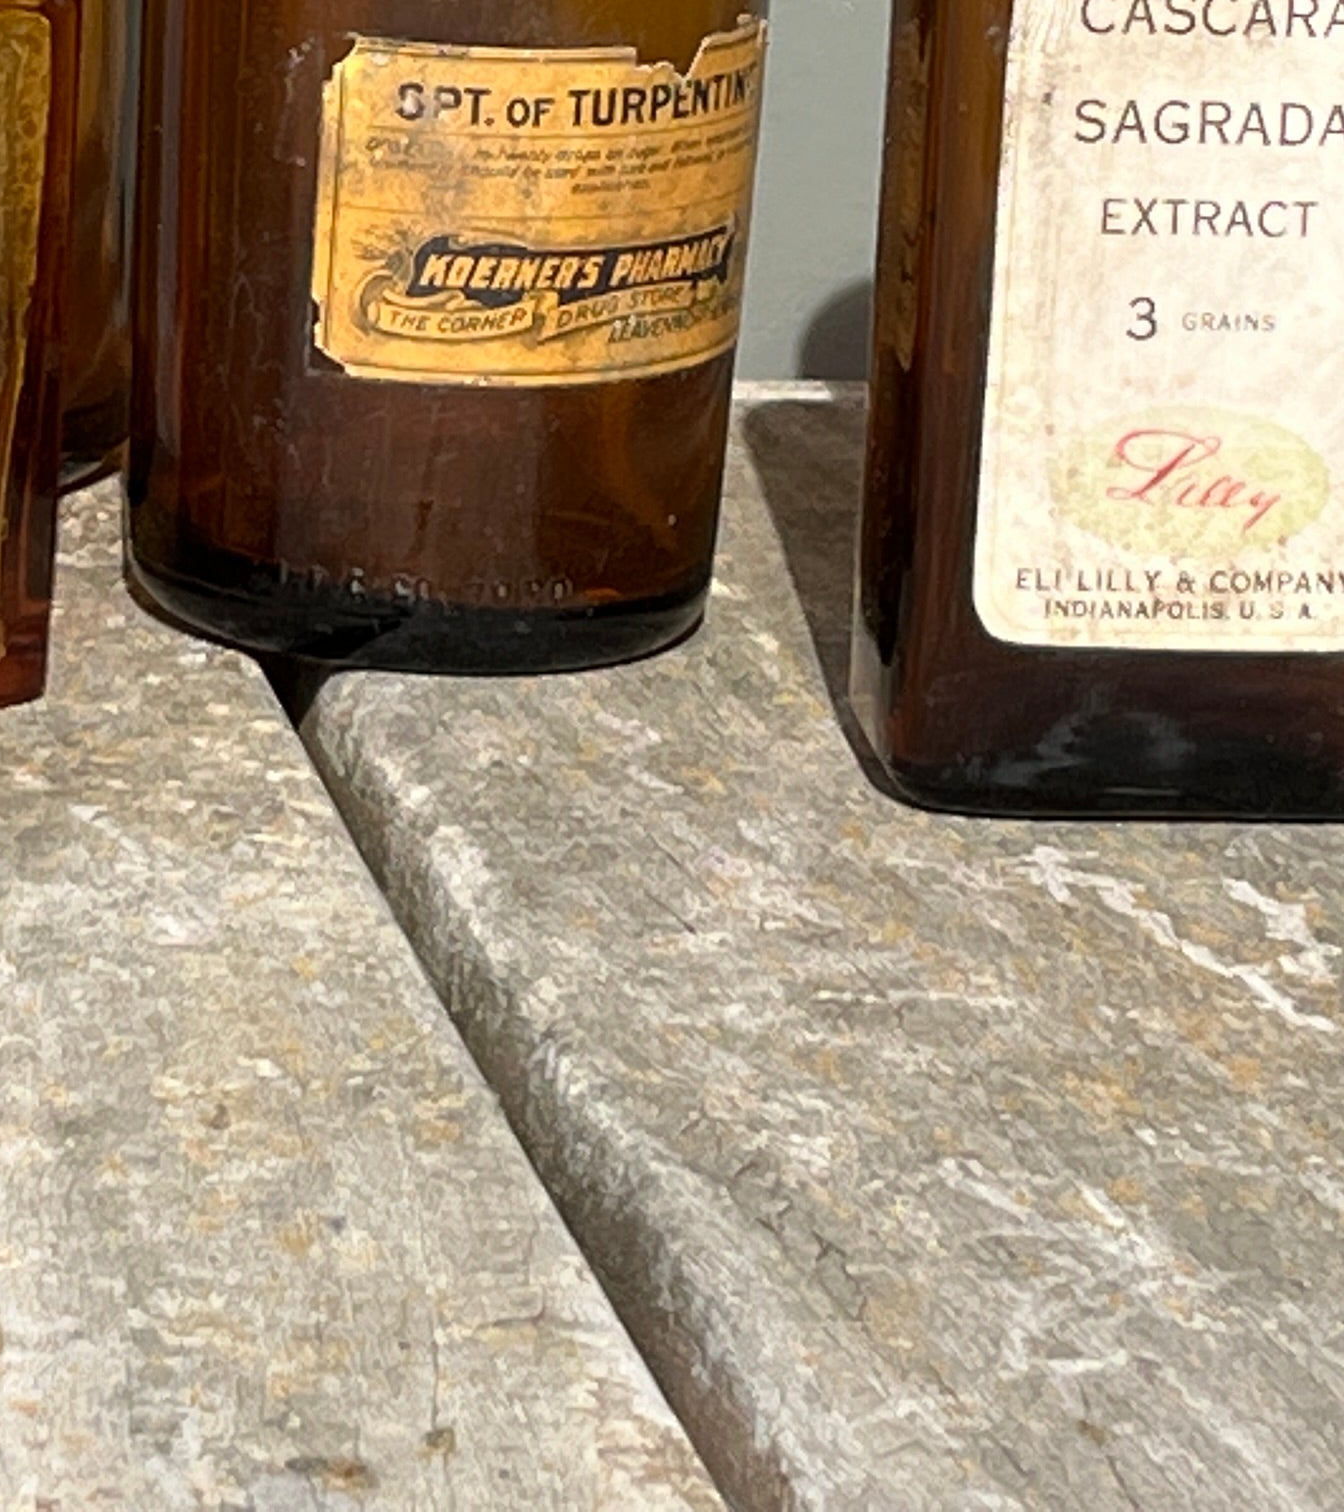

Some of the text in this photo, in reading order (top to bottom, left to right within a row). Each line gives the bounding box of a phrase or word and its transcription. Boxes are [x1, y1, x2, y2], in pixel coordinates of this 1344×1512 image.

[395, 68, 753, 128] SPT. OF TURPENTIN
[1100, 197, 1319, 239] EXTRACT
[388, 309, 431, 331] THE
[436, 306, 528, 334] CORNER
[557, 294, 620, 329] DRUG
[1125, 296, 1277, 341] 3 GRAINS
[1105, 428, 1282, 537] Lilly
[1015, 567, 1063, 592] ELI
[1077, 568, 1162, 592] LILLY
[1176, 570, 1196, 595] &
